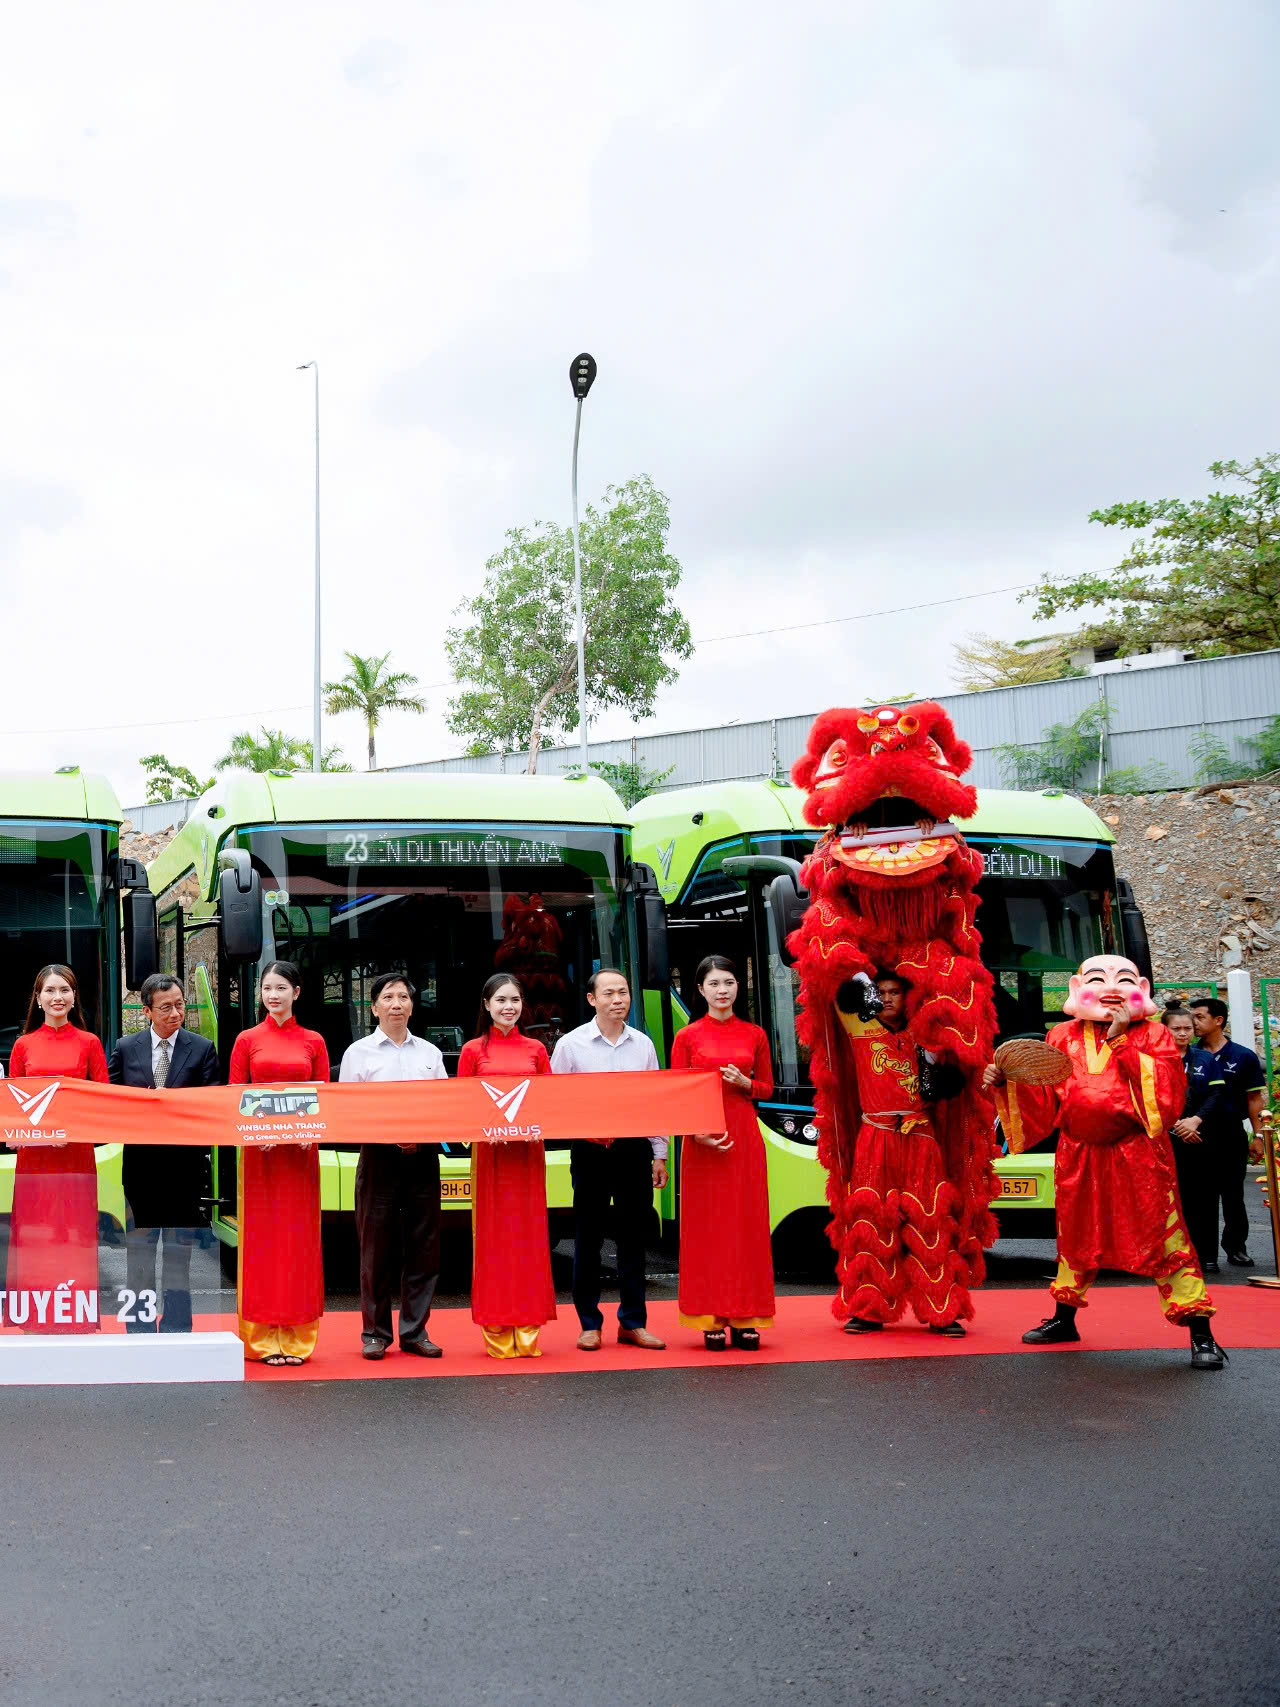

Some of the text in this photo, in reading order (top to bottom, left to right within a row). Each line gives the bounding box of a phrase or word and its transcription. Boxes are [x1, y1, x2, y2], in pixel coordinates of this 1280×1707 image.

[344, 833, 368, 862] 23
[407, 840, 432, 862] DU
[517, 840, 562, 862] ANA
[1019, 854, 1041, 876] DU
[4, 1128, 67, 1139] VINBUS
[235, 1122, 327, 1132] VINBUS NHA TRANG
[482, 1125, 541, 1137] VINBUS
[116, 1289, 157, 1323] 23
